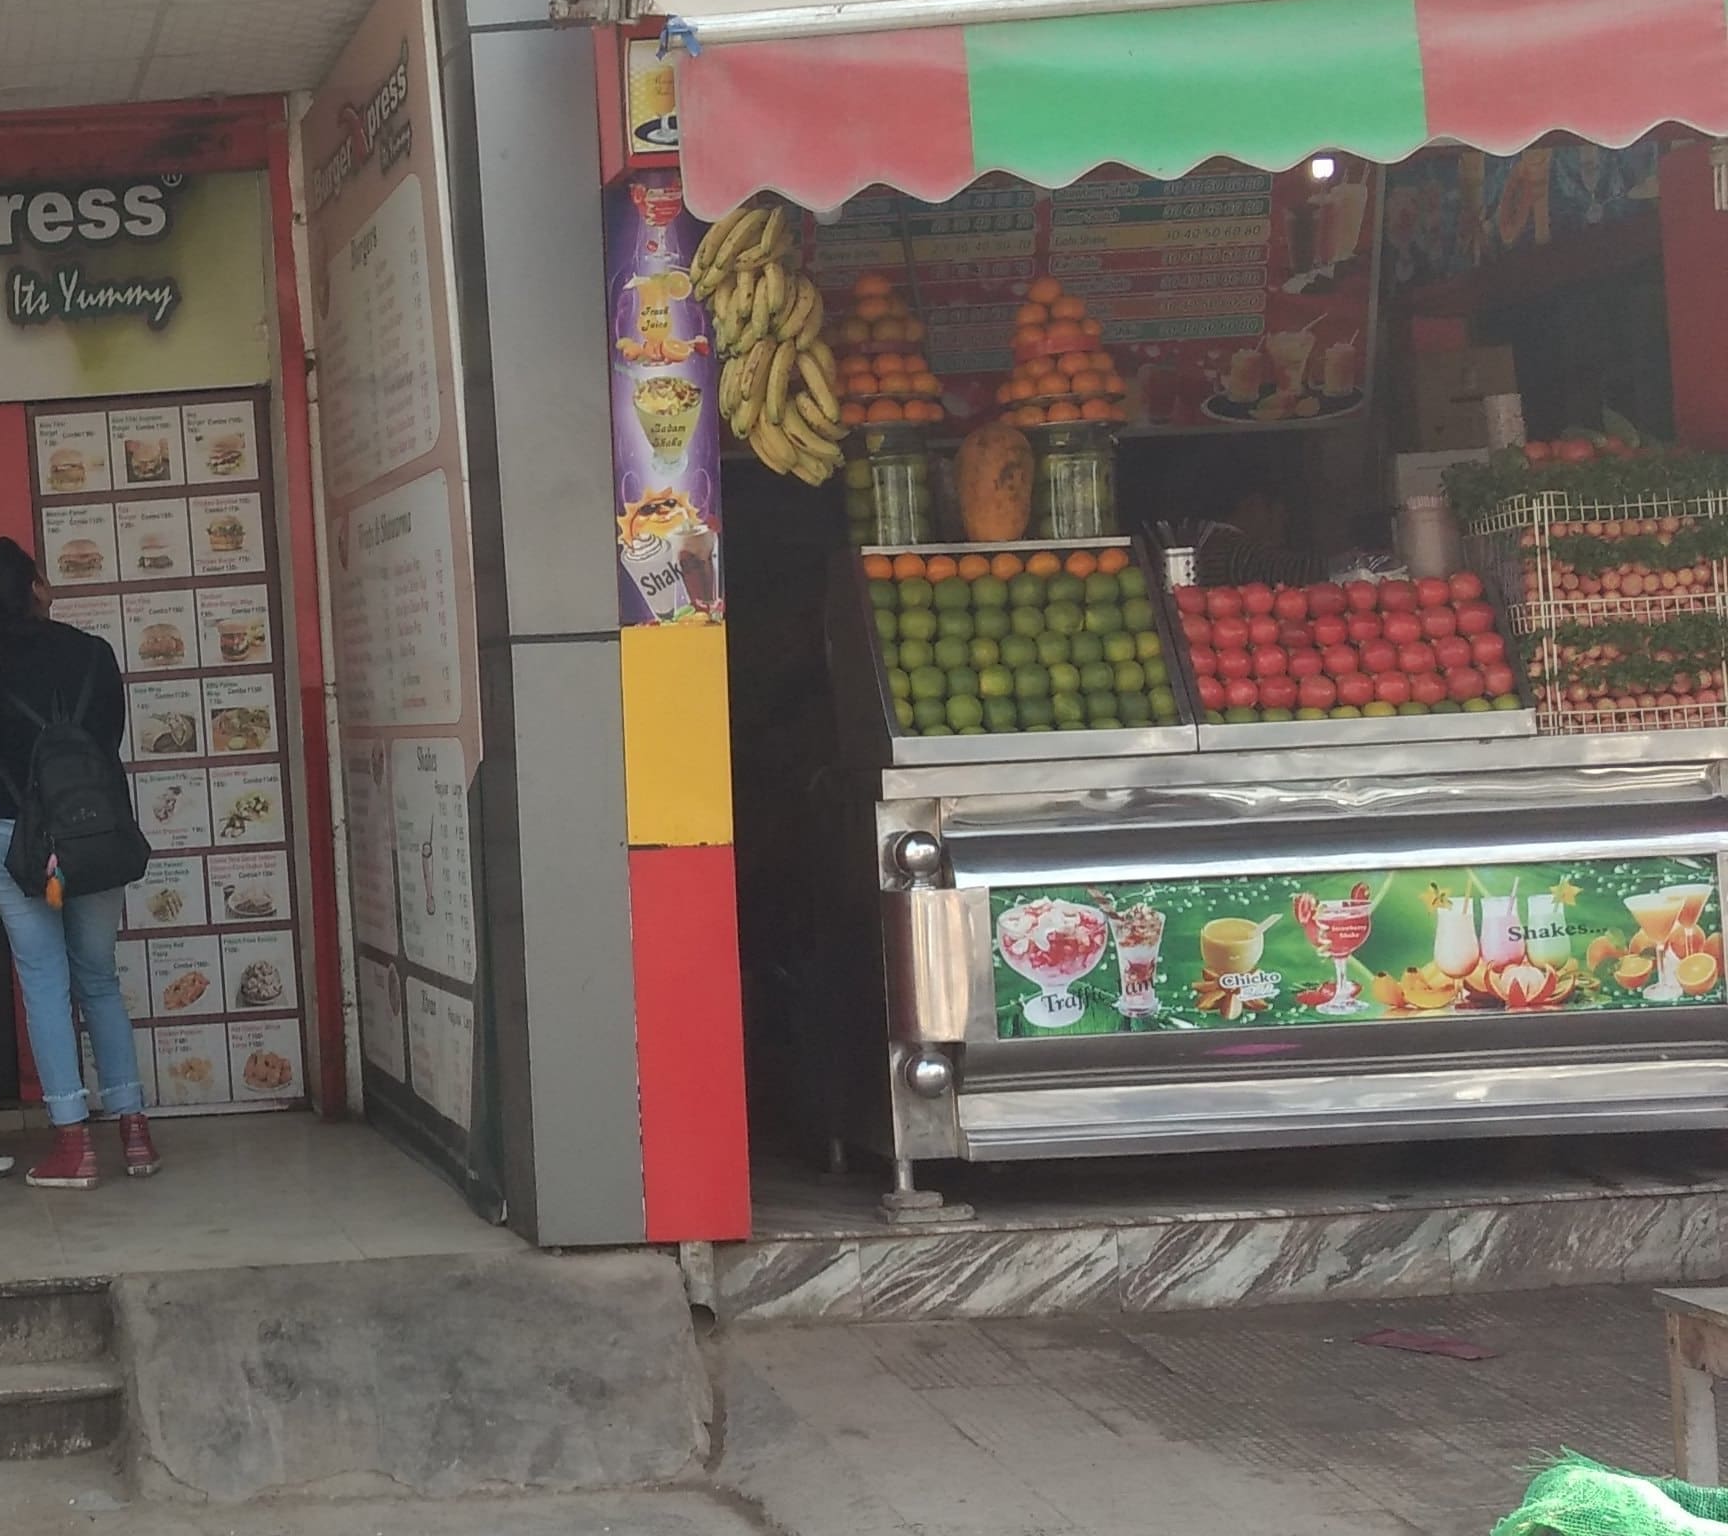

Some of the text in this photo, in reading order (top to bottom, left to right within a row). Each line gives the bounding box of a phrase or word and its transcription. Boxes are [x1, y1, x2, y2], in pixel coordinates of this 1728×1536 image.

[11, 270, 175, 322] Its Yummy
[639, 561, 683, 597] Shak
[1220, 971, 1281, 988] Chicko
[1040, 987, 1107, 1015] Traffic
